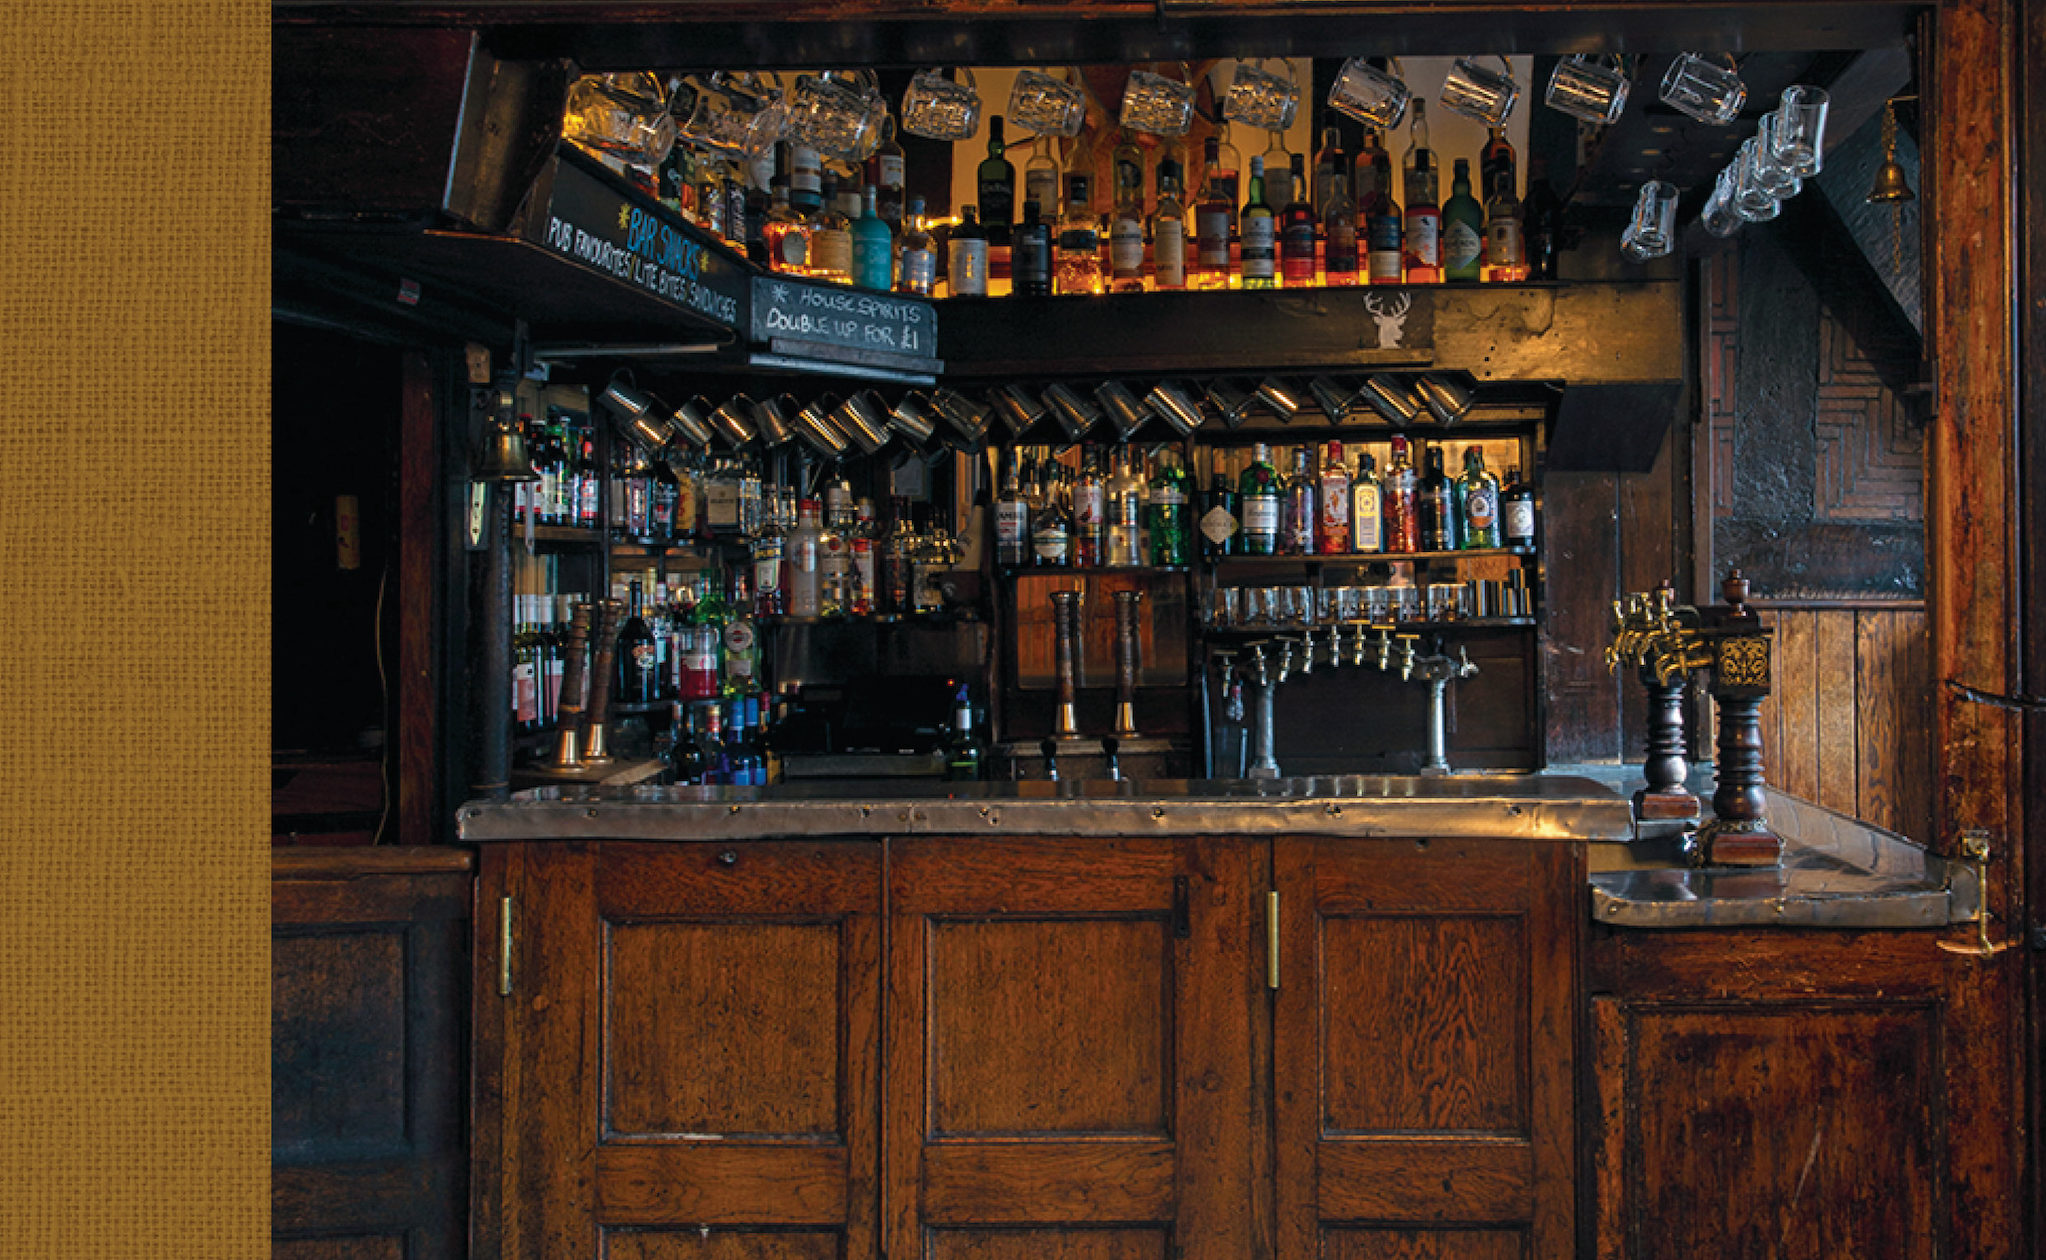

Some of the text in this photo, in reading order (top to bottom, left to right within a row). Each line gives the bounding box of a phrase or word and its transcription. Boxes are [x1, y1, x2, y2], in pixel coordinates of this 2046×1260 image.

[548, 216, 574, 252] PUB
[634, 258, 660, 291] LITE
[627, 207, 702, 281] BAR SNACKS
[766, 307, 919, 350] DOUBLE UP FOR £1
[799, 288, 922, 324] HOUSE SPIRITS
